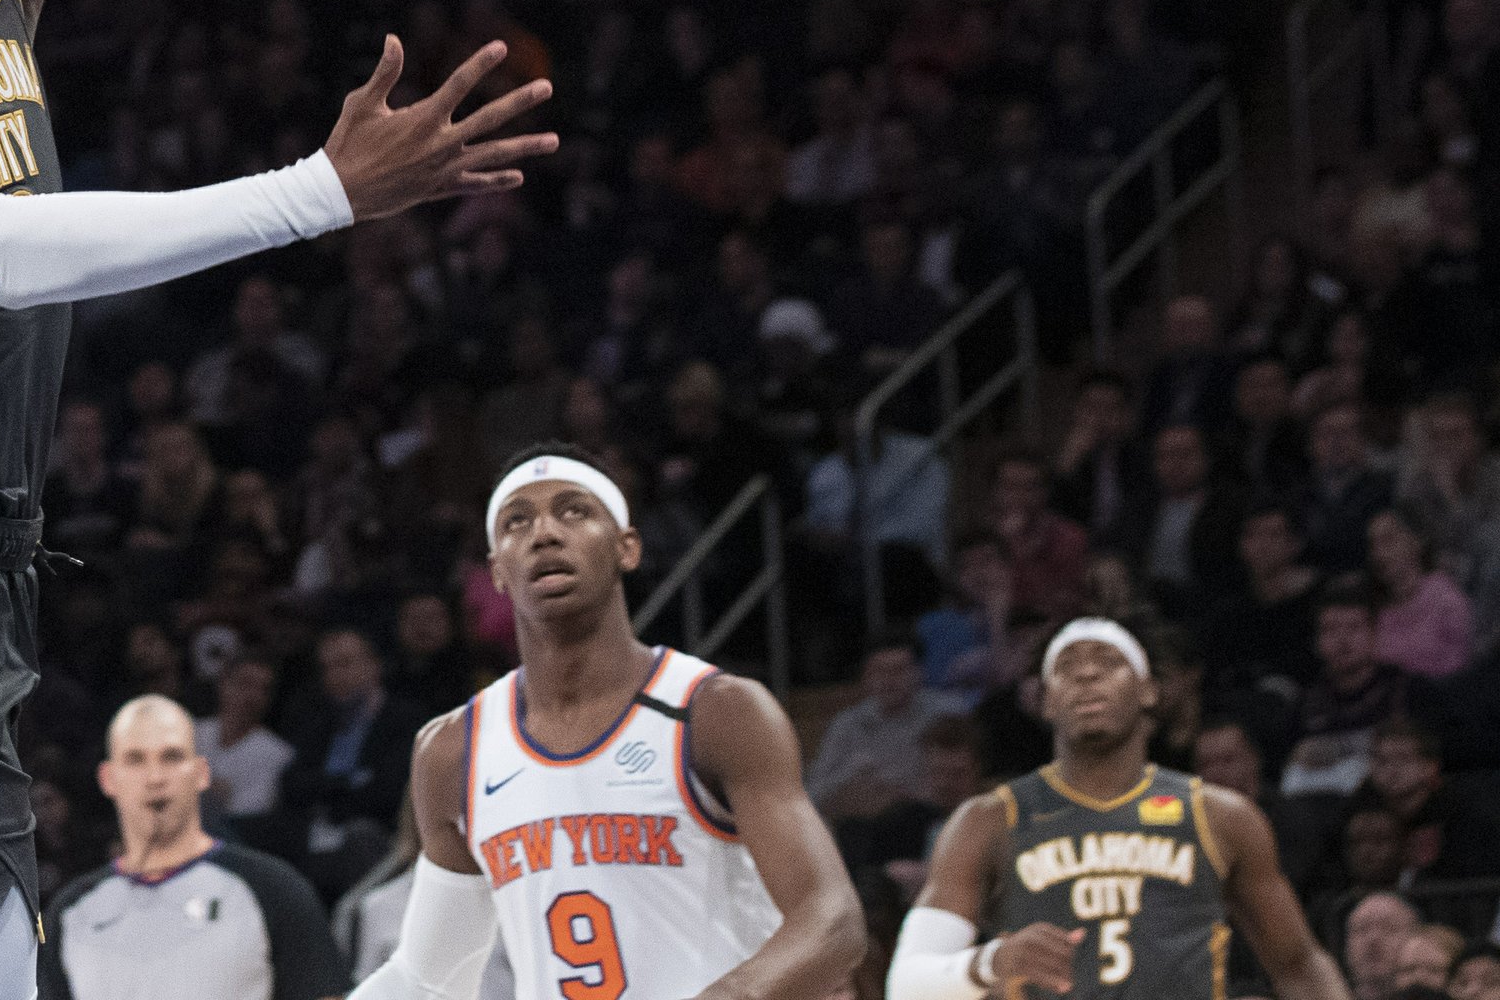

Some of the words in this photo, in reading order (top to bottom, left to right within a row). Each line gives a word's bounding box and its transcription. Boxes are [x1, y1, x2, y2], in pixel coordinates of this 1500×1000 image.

[480, 816, 556, 890] NEW
[560, 813, 685, 868] YORK
[1015, 831, 1196, 894] OKLAHOMA
[1070, 875, 1144, 921] CITY
[545, 889, 629, 1000] 9
[1098, 918, 1135, 986] 5
